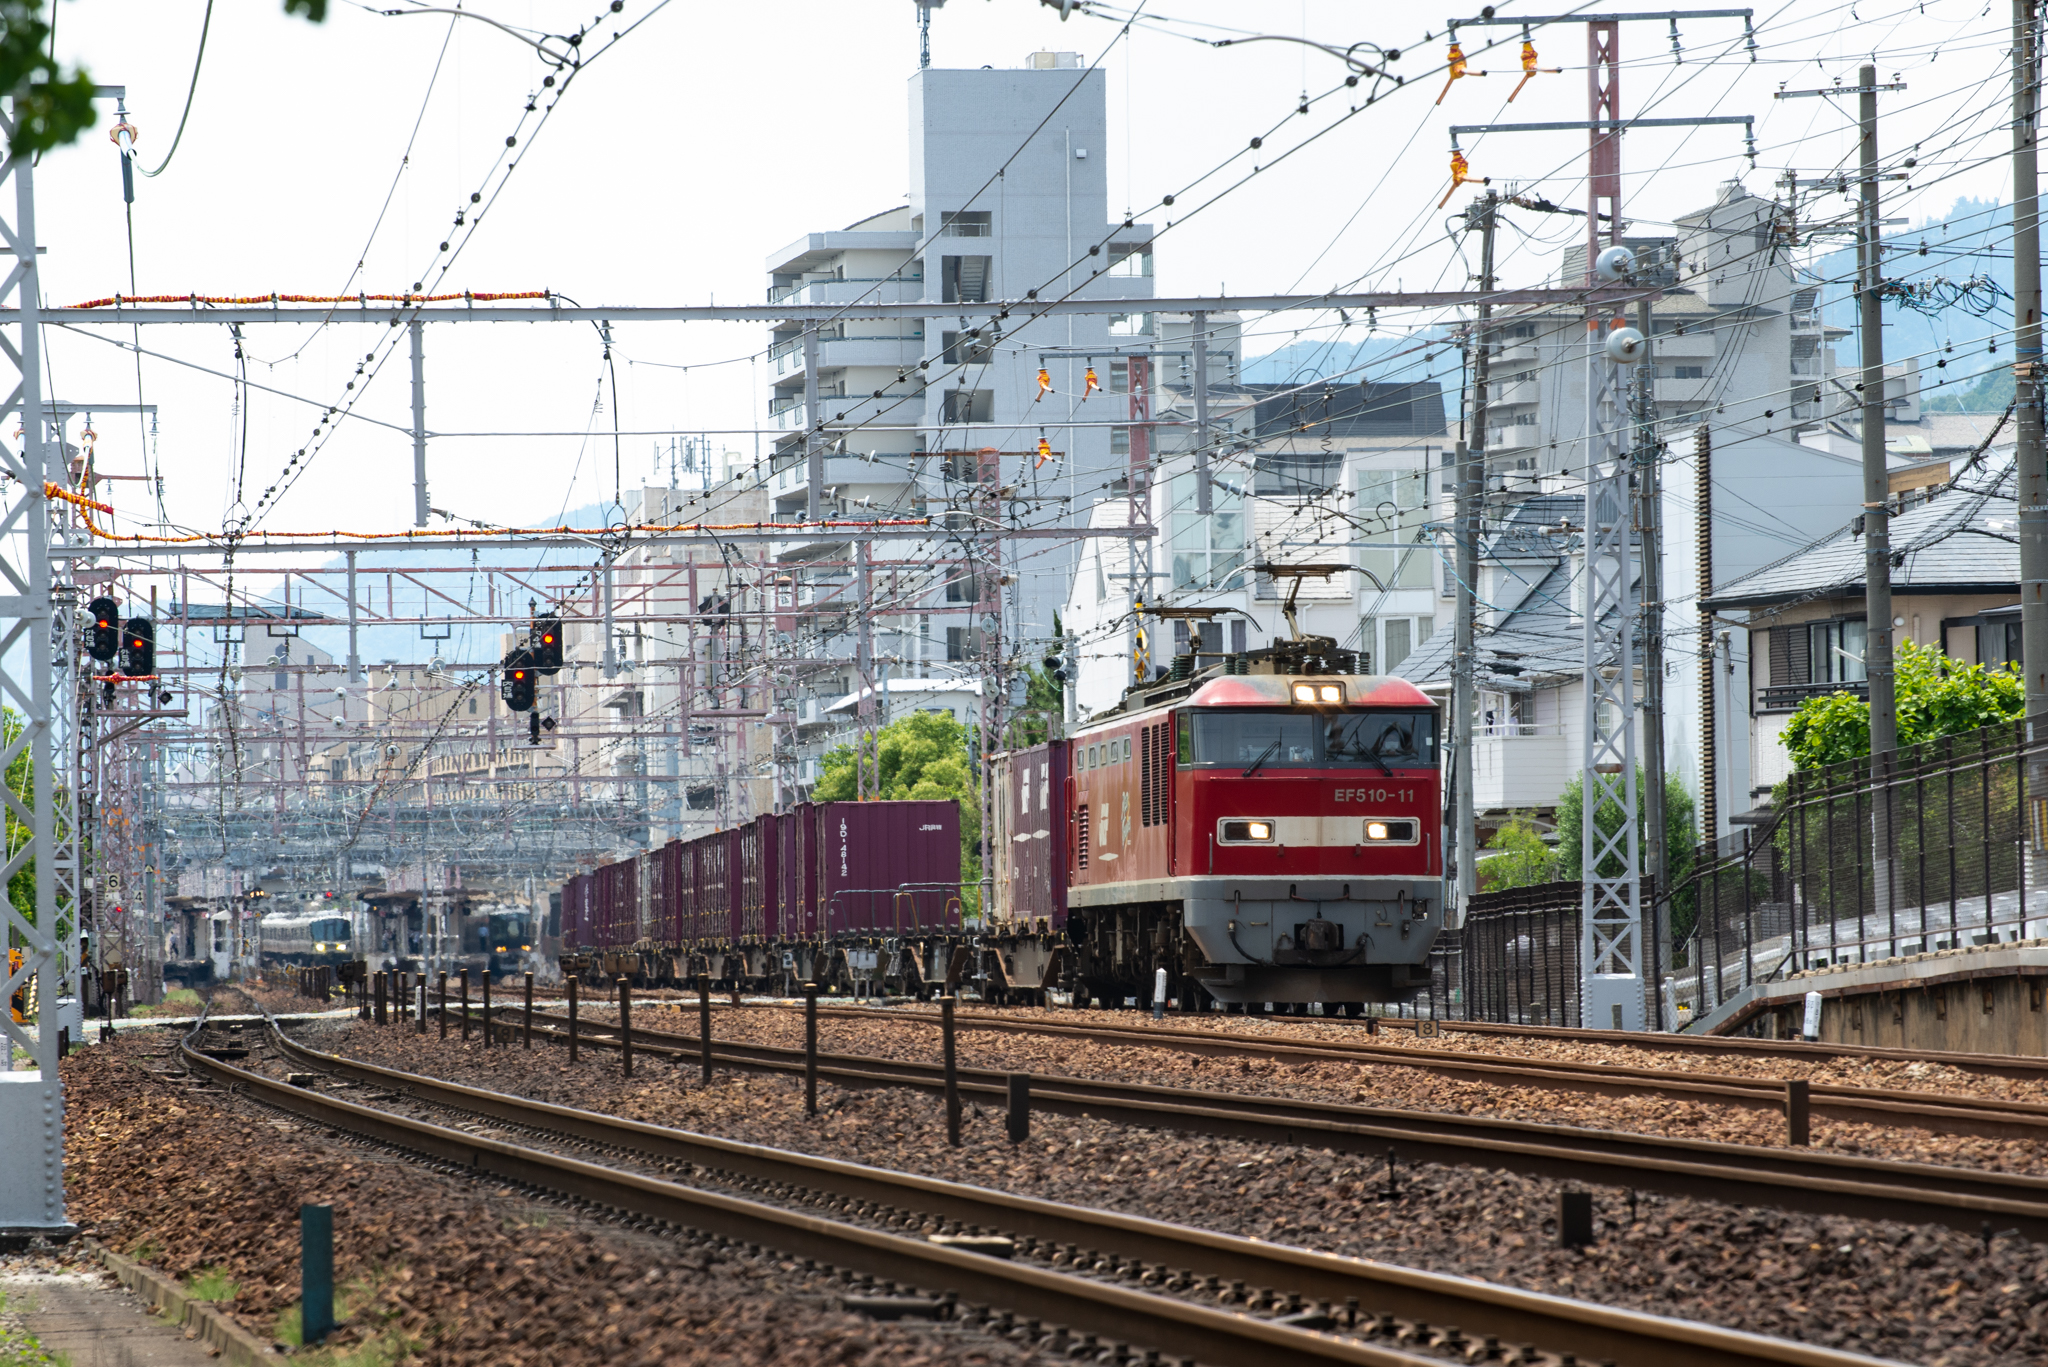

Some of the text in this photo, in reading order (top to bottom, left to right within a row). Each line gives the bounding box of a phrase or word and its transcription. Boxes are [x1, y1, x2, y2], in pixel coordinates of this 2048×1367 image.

[1334, 788, 1414, 803] EF510-11
[108, 874, 118, 888] 6
[135, 891, 143, 901] 4
[1422, 1022, 1433, 1035] 8
